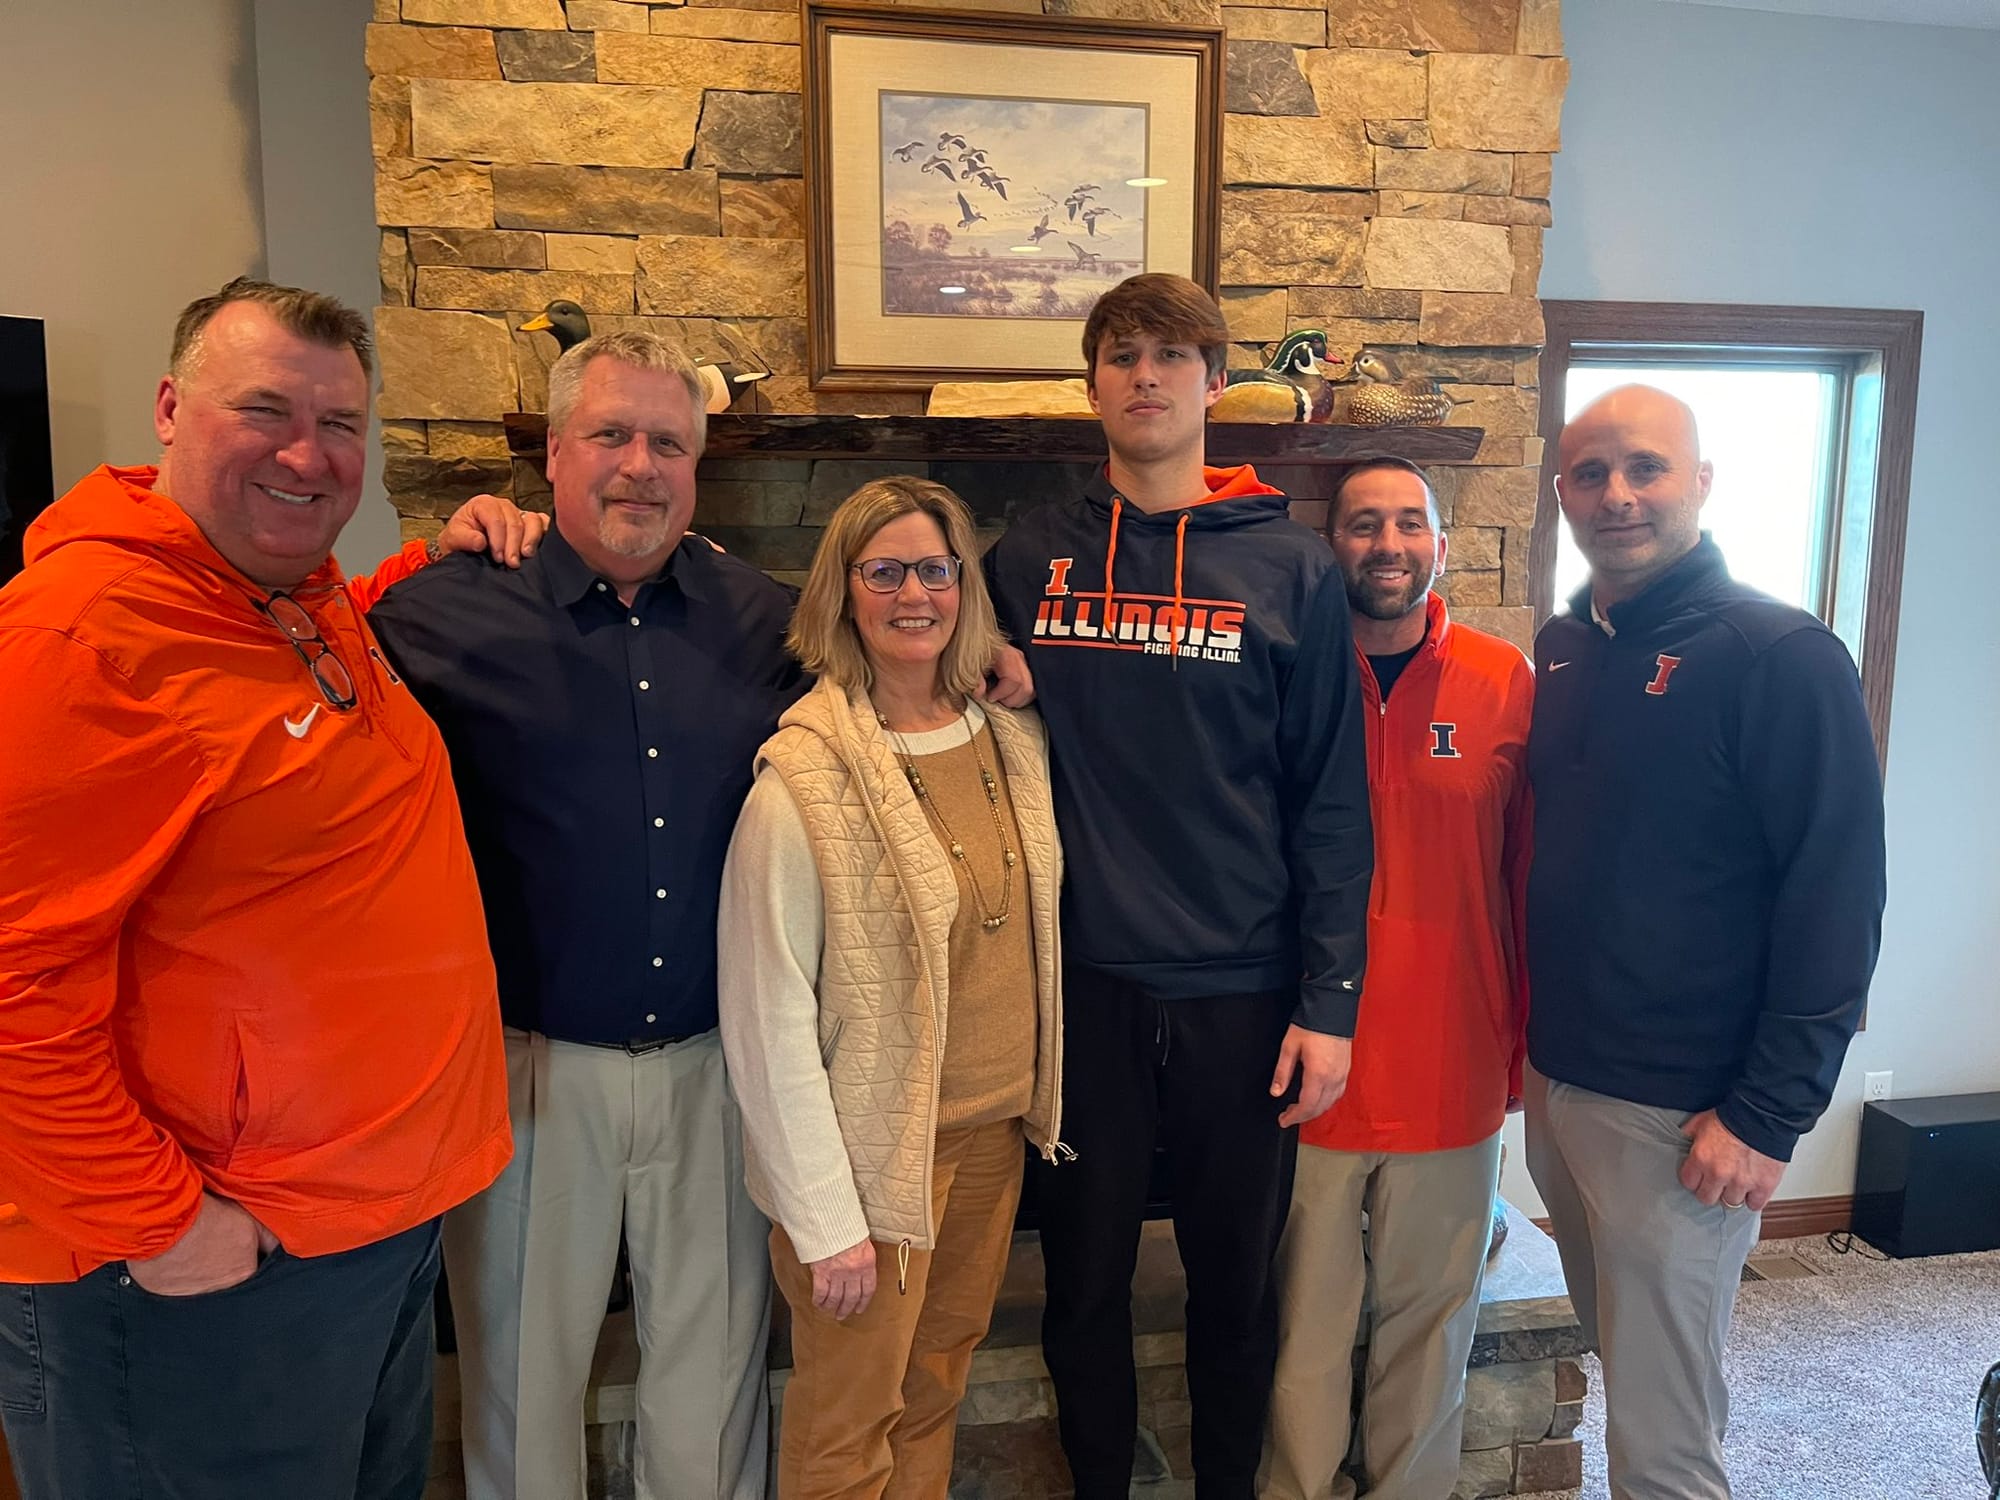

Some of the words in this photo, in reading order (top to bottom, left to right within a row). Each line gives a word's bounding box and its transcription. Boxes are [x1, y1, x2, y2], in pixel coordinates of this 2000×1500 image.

[1045, 558, 1073, 596] I
[1033, 600, 1244, 649] ILLINOIS
[1144, 642, 1200, 658] FIGHING
[1202, 647, 1239, 663] ILLINI
[1644, 654, 1682, 695] I
[1430, 722, 1457, 758] I
